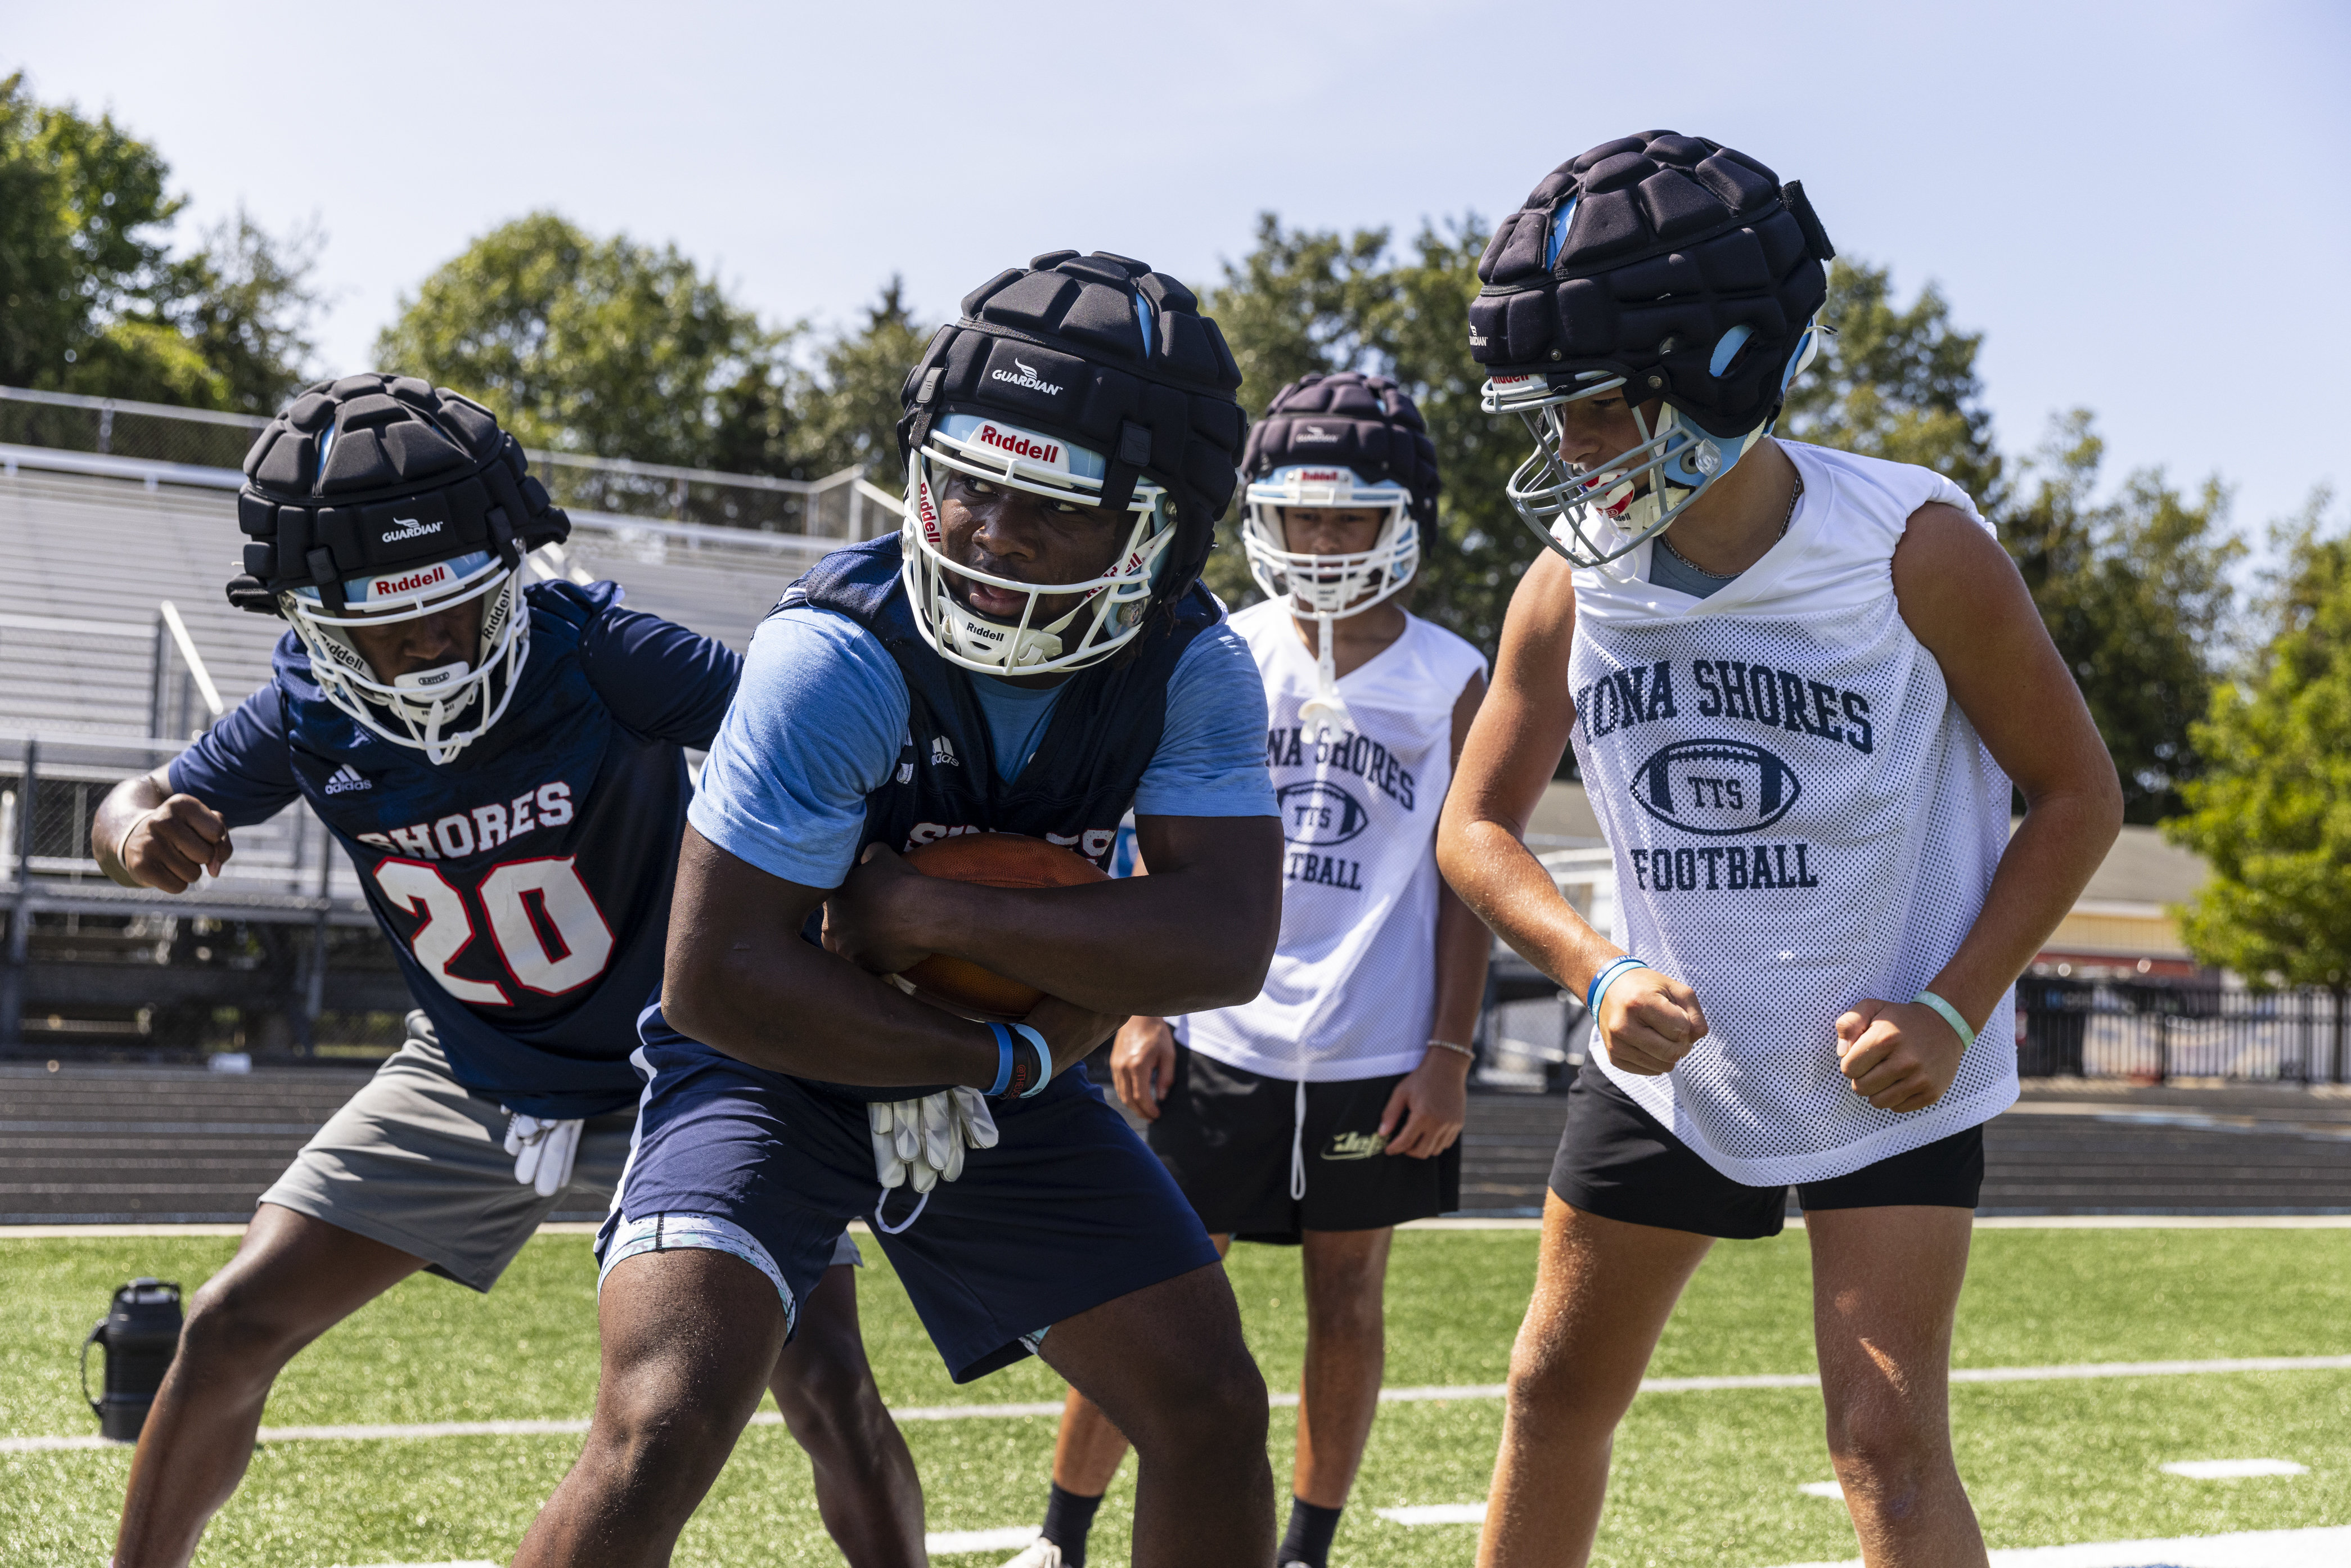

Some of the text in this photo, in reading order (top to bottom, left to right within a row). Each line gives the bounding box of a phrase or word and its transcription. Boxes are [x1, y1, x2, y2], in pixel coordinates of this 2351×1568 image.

[992, 370, 1059, 395] GUARDIAN
[981, 425, 1059, 463] Riddell
[382, 522, 441, 543] GUARDIAN
[376, 566, 445, 595] Riddell
[967, 622, 1005, 642] Riddell
[321, 636, 364, 670] ddell
[422, 673, 447, 684] BATTLE
[1693, 659, 1873, 755] SHORES
[1265, 728, 1302, 766] NA
[325, 780, 372, 794] adidas
[1688, 777, 1743, 810] TTS
[1295, 806, 1331, 828] TTS
[1289, 852, 1362, 891] TBALL
[1631, 843, 1818, 891] FOOTBALL
[373, 854, 616, 1006] 20
